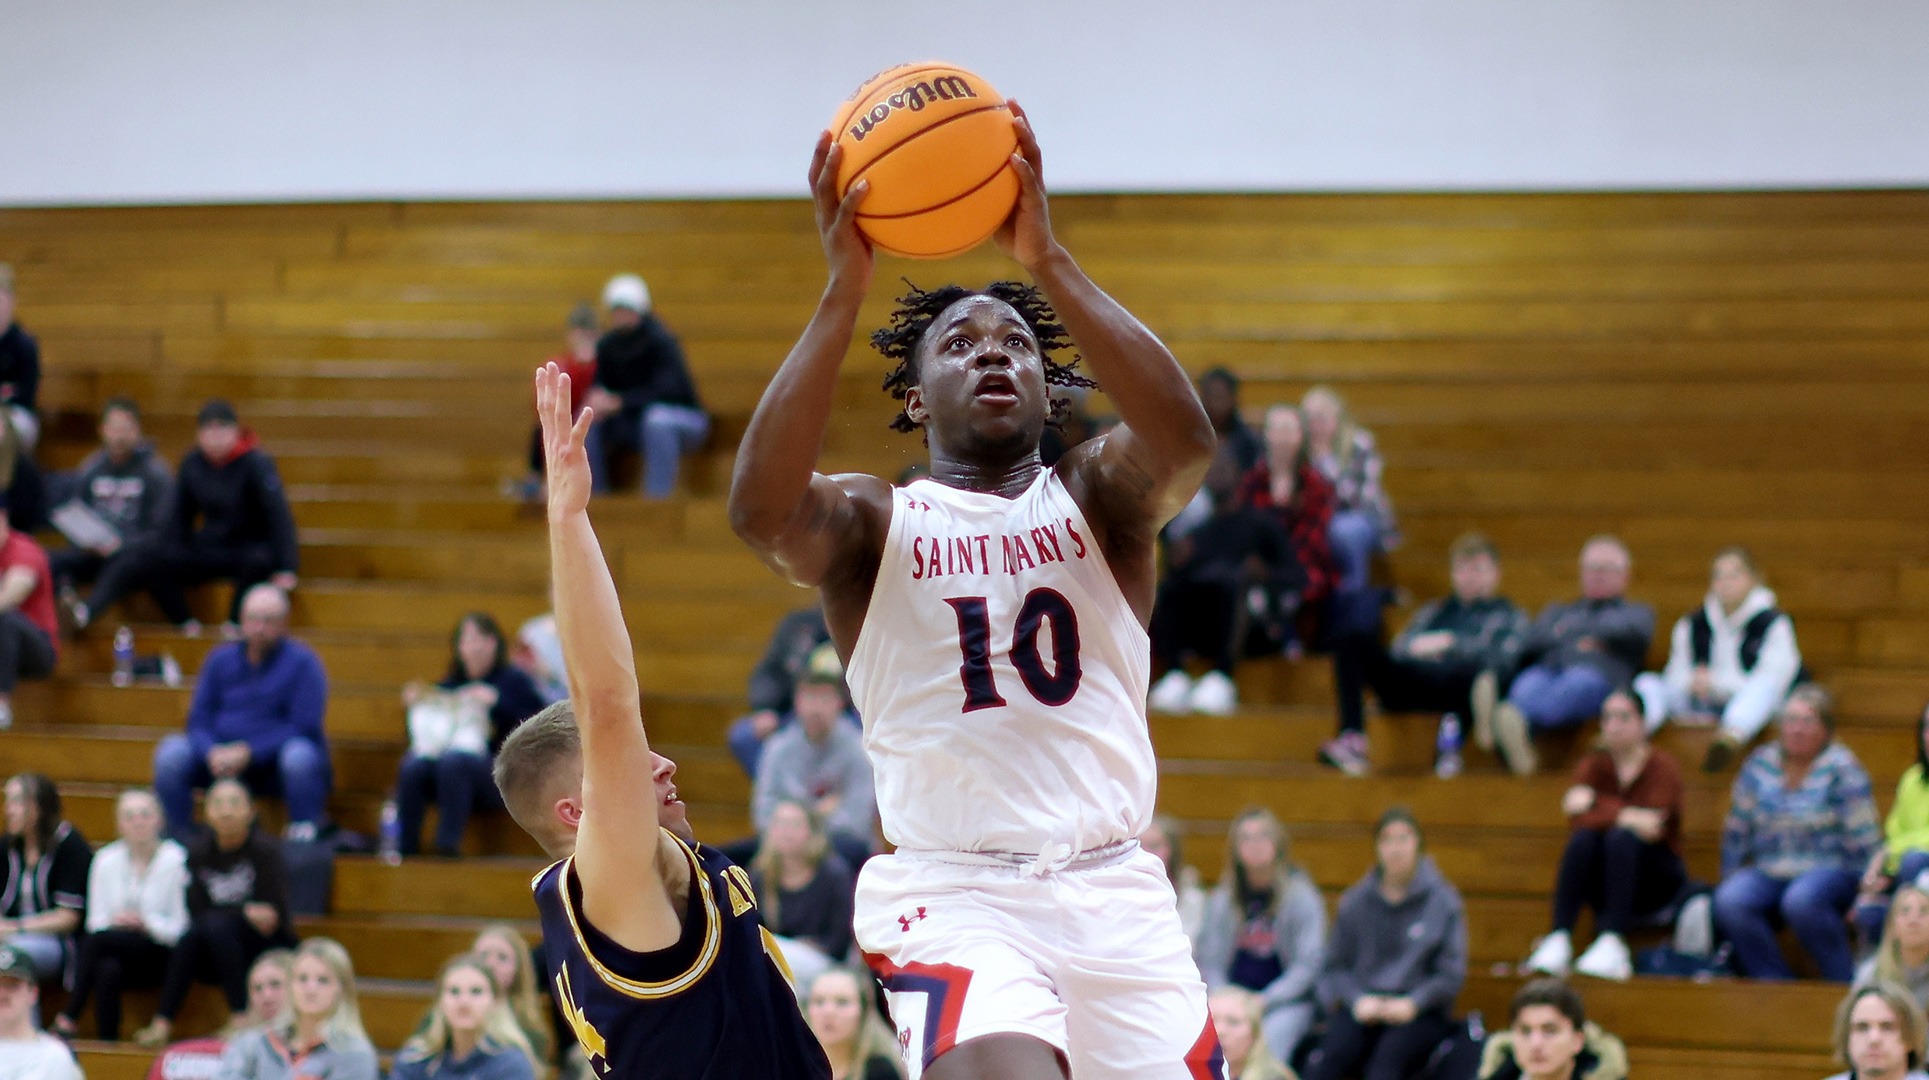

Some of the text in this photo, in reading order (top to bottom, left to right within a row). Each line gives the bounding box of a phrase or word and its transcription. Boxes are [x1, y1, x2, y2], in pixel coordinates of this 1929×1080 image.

[849, 75, 978, 142] Wilson
[912, 534, 990, 580] SAINT
[942, 587, 1083, 714] 10
